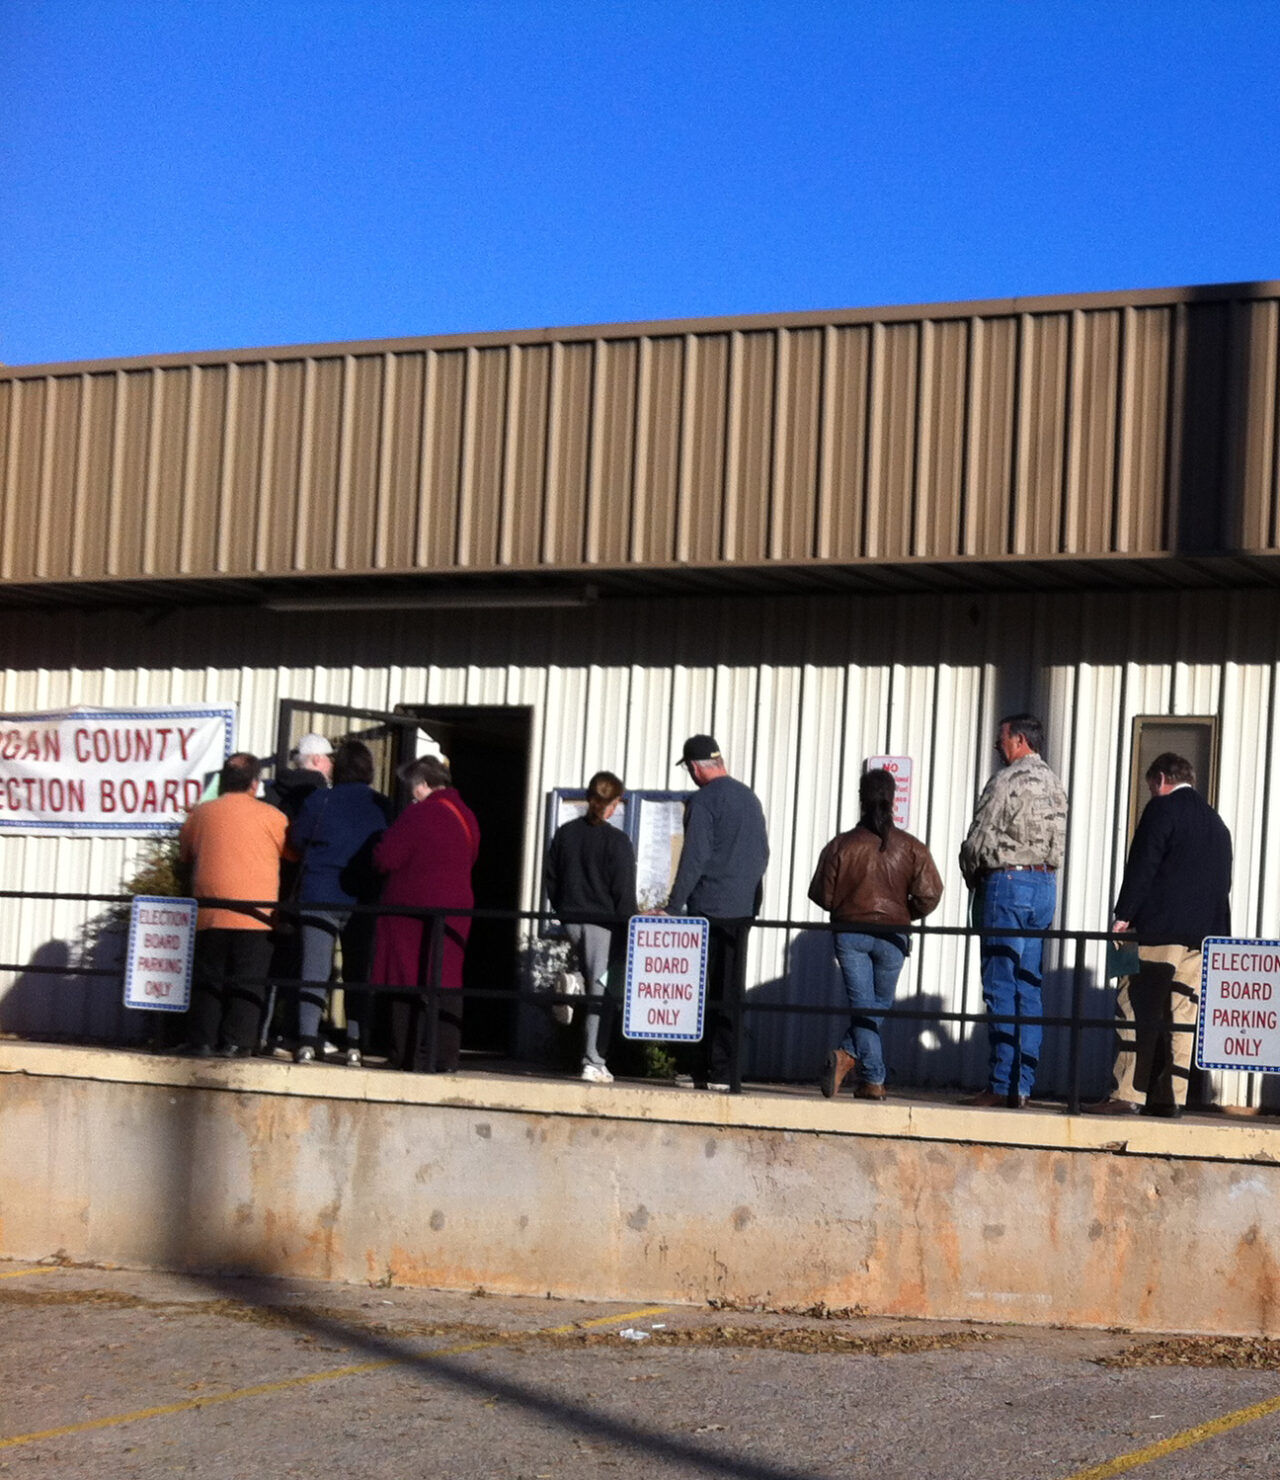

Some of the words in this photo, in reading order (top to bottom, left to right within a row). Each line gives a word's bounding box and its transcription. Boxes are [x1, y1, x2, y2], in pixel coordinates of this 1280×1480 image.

[0, 729, 61, 762] GAN
[75, 728, 197, 763] COUNTY
[100, 779, 202, 813] BOARD
[140, 909, 190, 926] ELECTION
[144, 933, 181, 950] BOARD
[637, 930, 699, 949] ELECTION
[137, 956, 182, 974] PARKING
[644, 956, 689, 974] BOARD
[145, 980, 173, 997] ONLY
[637, 982, 693, 1001] PARKING
[1220, 981, 1272, 1000] BOARD
[647, 1008, 680, 1026] ONLY
[1212, 1009, 1277, 1030] PARKING
[1224, 1037, 1263, 1057] ONLY
